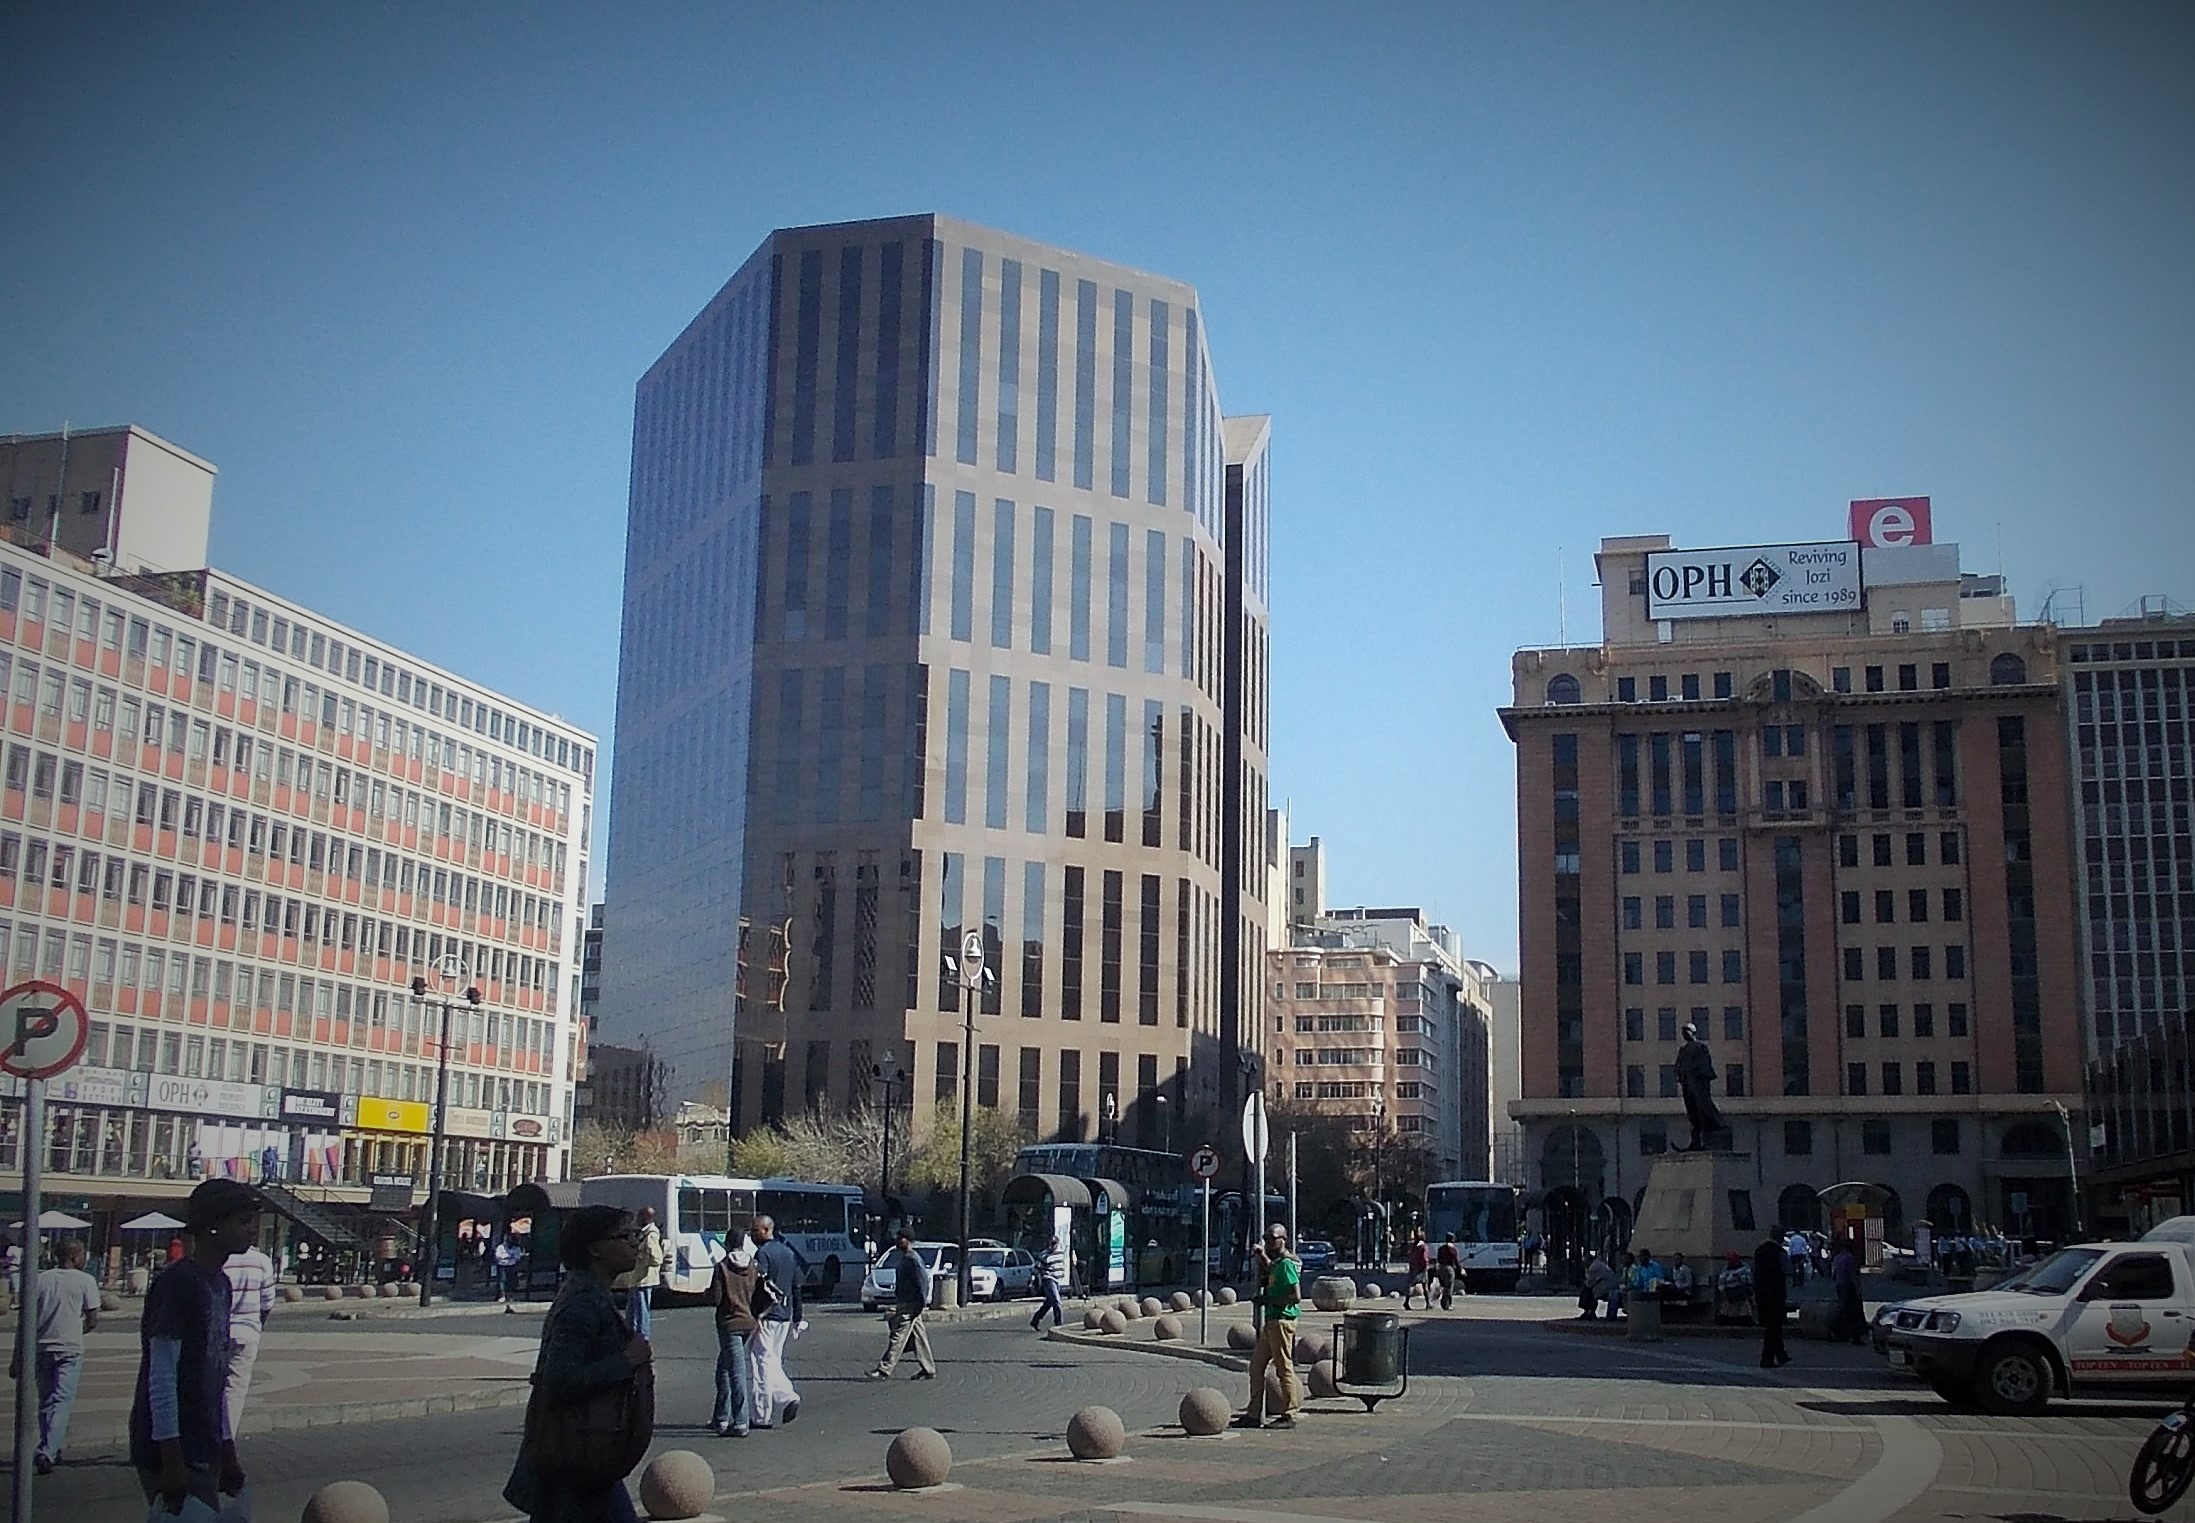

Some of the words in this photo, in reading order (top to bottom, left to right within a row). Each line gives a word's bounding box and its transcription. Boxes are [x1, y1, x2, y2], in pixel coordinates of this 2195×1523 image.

[1869, 506, 1915, 548] e
[1789, 549, 1847, 566] Reviving
[1653, 563, 1733, 600] OPH
[1805, 568, 1831, 585] Jozi
[1782, 590, 1819, 605] since
[1824, 588, 1857, 605] 1989
[15, 1007, 59, 1056] P
[159, 1081, 189, 1104] OPH
[1199, 1155, 1213, 1171] P
[2076, 1361, 2096, 1370] TOP
[2098, 1361, 2118, 1369] TEN
[2128, 1361, 2148, 1369] TOP
[2149, 1361, 2169, 1369] TEN
